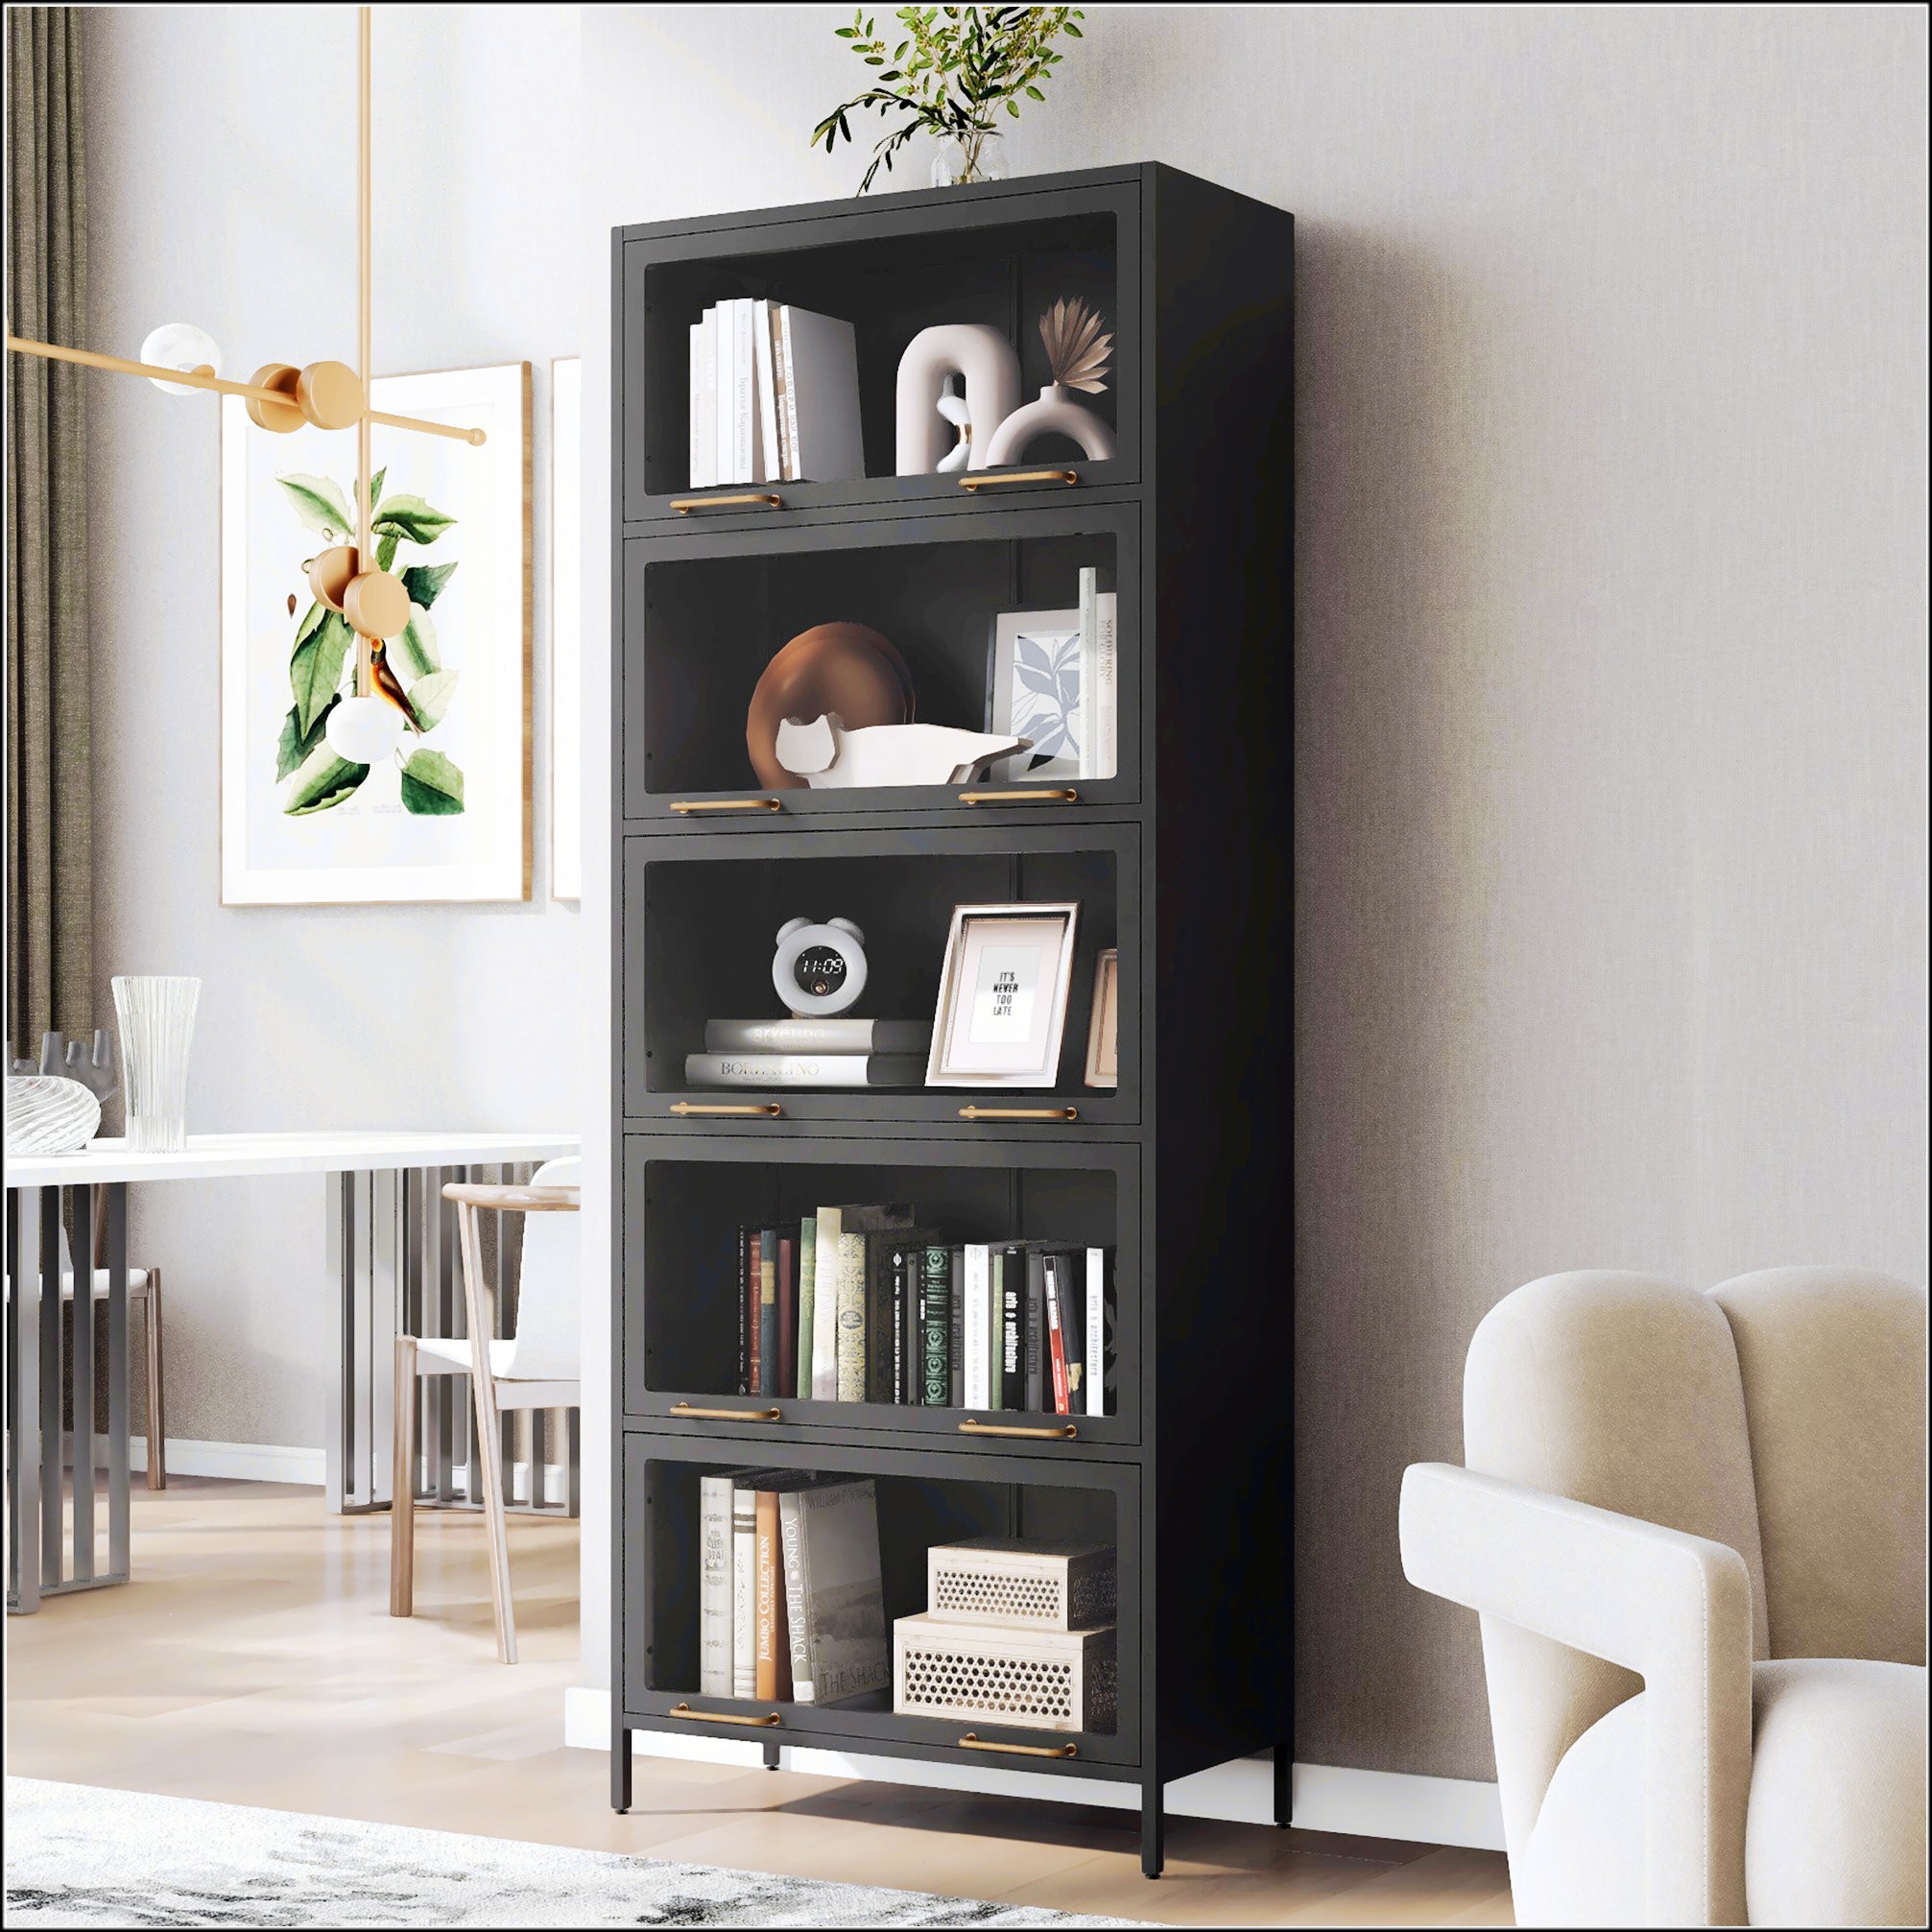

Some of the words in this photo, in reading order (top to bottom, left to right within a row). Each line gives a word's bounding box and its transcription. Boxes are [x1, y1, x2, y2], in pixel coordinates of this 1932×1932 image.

[802, 959, 845, 974] 11:09
[999, 971, 1015, 982] IT'S
[992, 983, 1018, 993] NEVER
[996, 994, 1013, 1005] TOO
[992, 1006, 1012, 1016] LATE
[1005, 1291, 1017, 1309] arts
[1005, 1322, 1019, 1373] architecture
[785, 1517, 800, 1568] YOUNG
[758, 1535, 771, 1614] COLLECTION
[788, 1583, 803, 1613] THE
[758, 1618, 772, 1661] JUMBO
[790, 1616, 807, 1664] SHACK
[820, 1671, 847, 1696] THE
